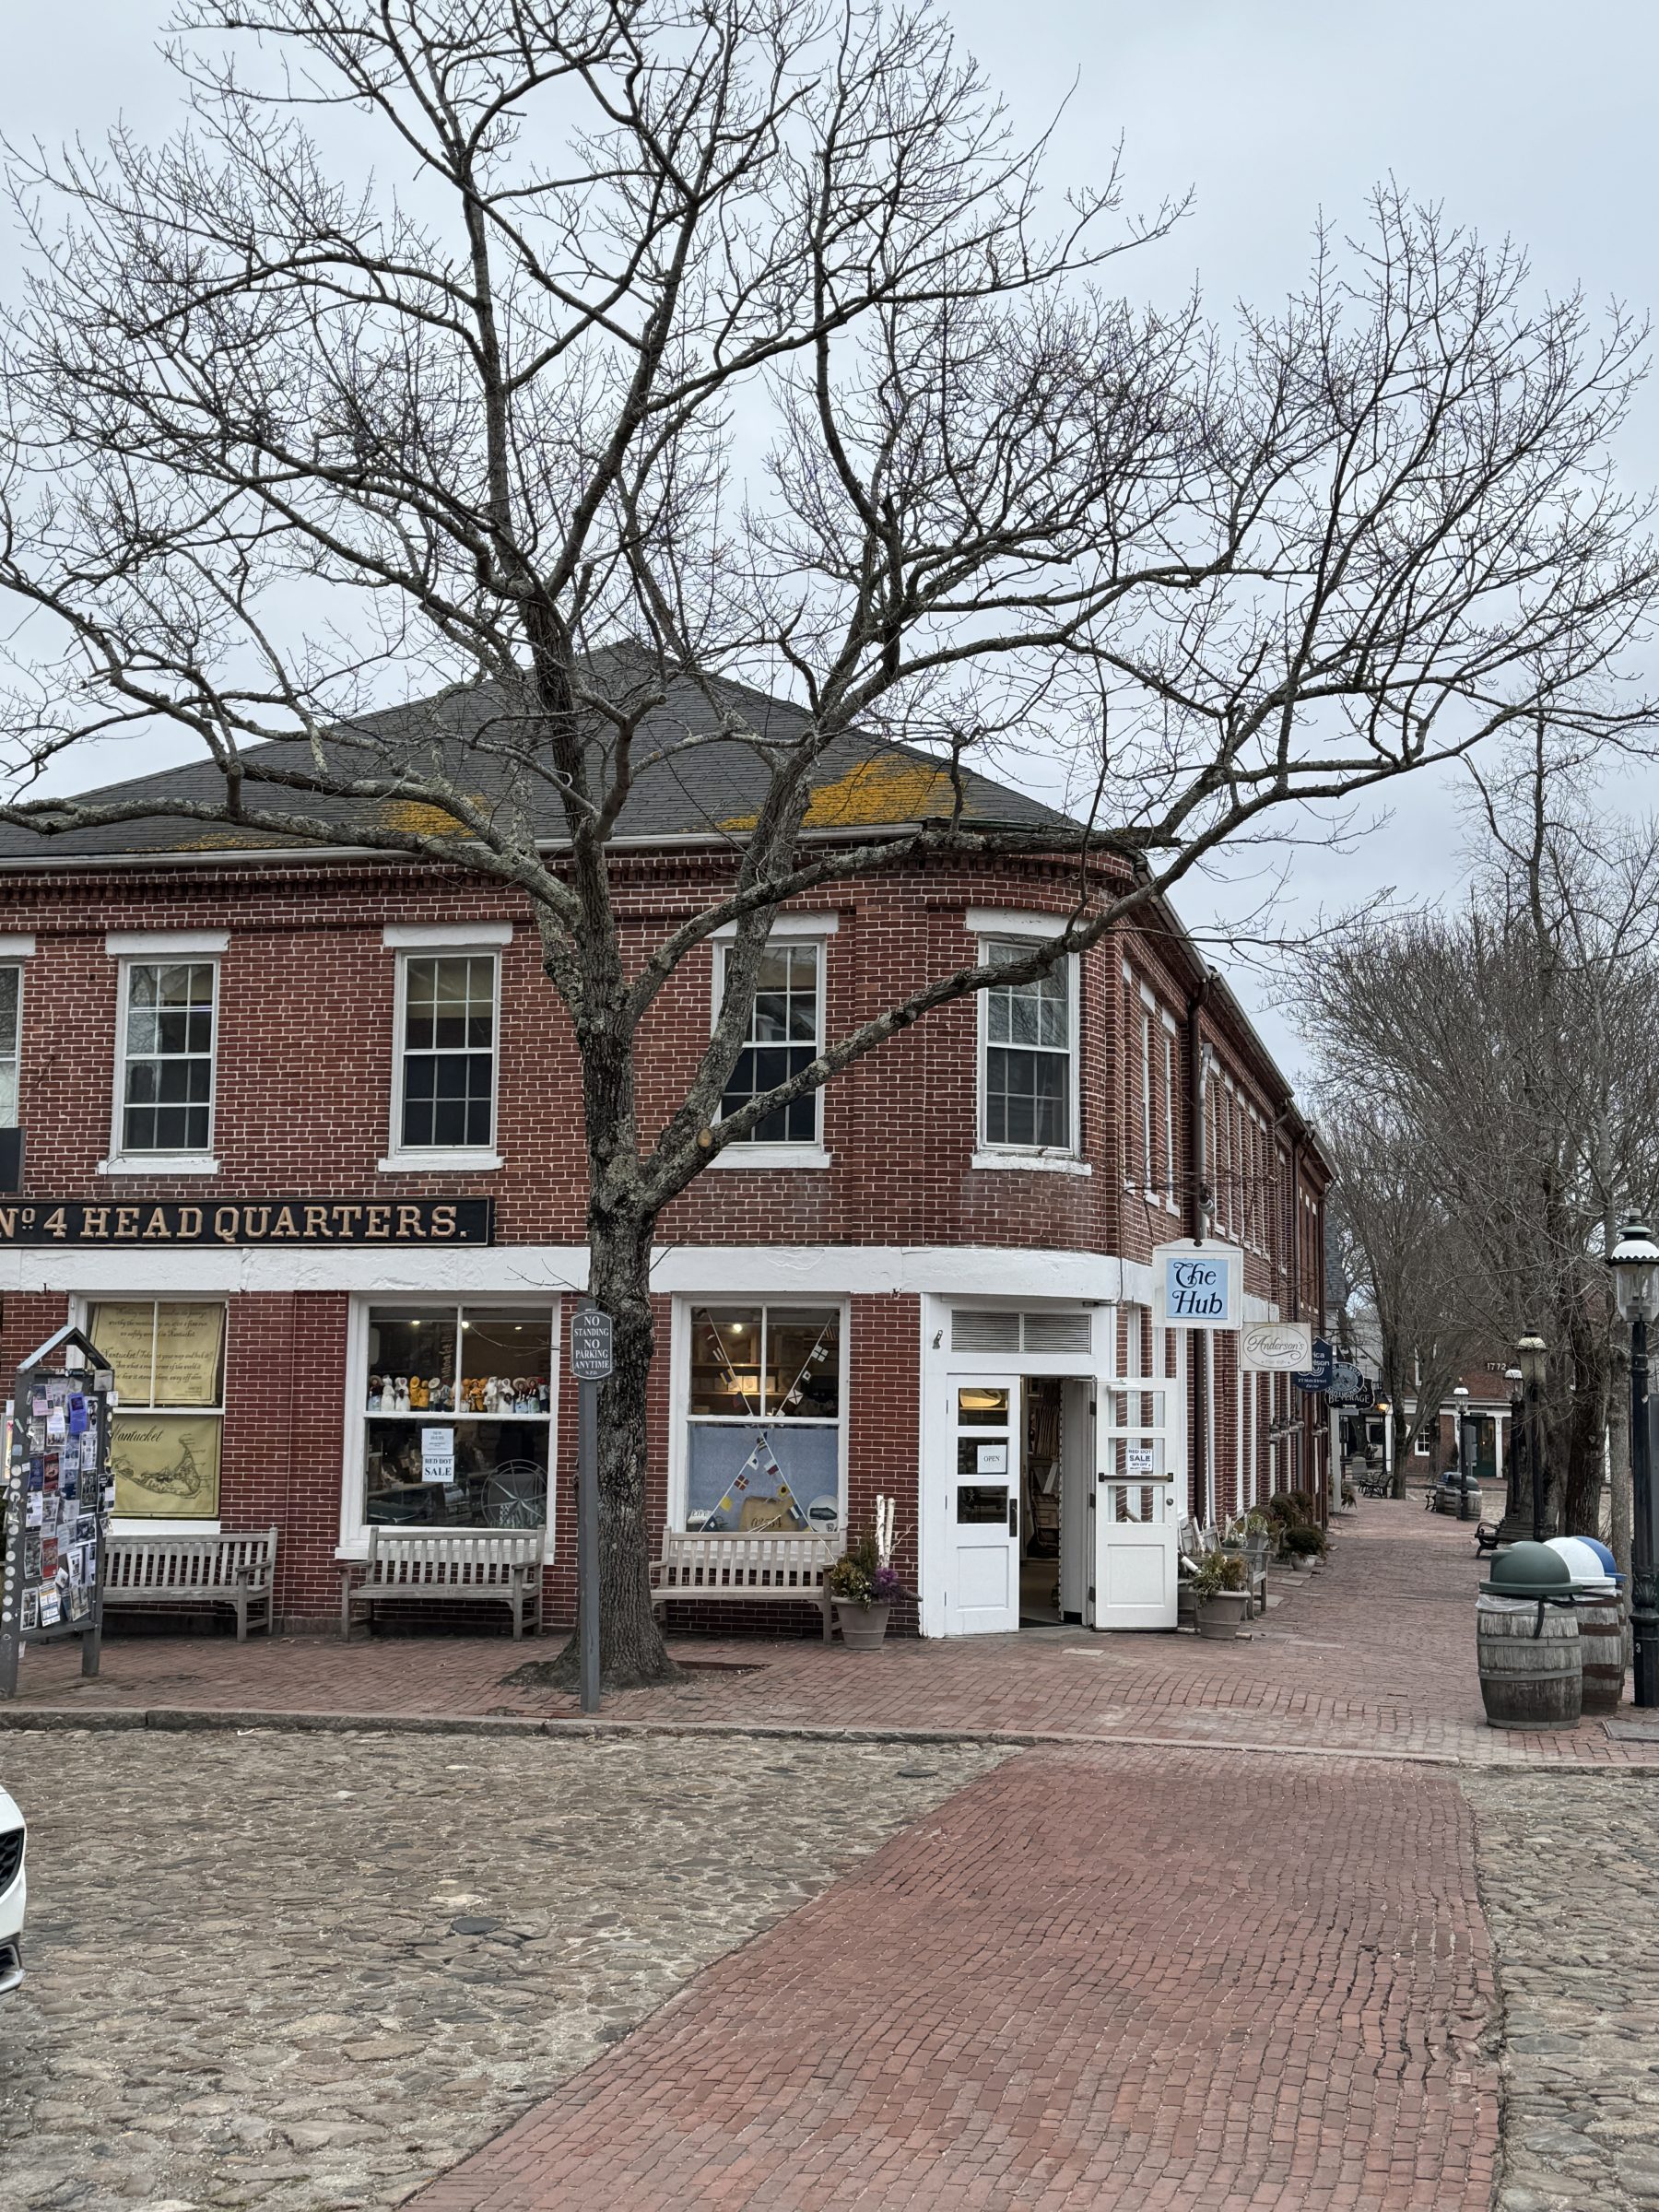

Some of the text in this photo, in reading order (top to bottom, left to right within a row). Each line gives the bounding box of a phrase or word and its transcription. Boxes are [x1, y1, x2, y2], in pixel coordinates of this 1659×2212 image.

[43, 1207, 67, 1238] 4
[80, 1207, 203, 1239] HEAD
[214, 1206, 467, 1243] QUARTERS.
[1173, 1262, 1217, 1288] The
[1171, 1290, 1223, 1314] Hub
[583, 1315, 600, 1326] NO
[574, 1328, 608, 1336] STANDING
[583, 1338, 600, 1349] NO
[1247, 1335, 1304, 1356] Anderson's
[575, 1349, 608, 1359] PARKING
[574, 1359, 609, 1369] ANYTIME
[1487, 1362, 1507, 1371] 1772
[424, 1466, 453, 1477] SALE
[1635, 1642, 1641, 1653] 3
